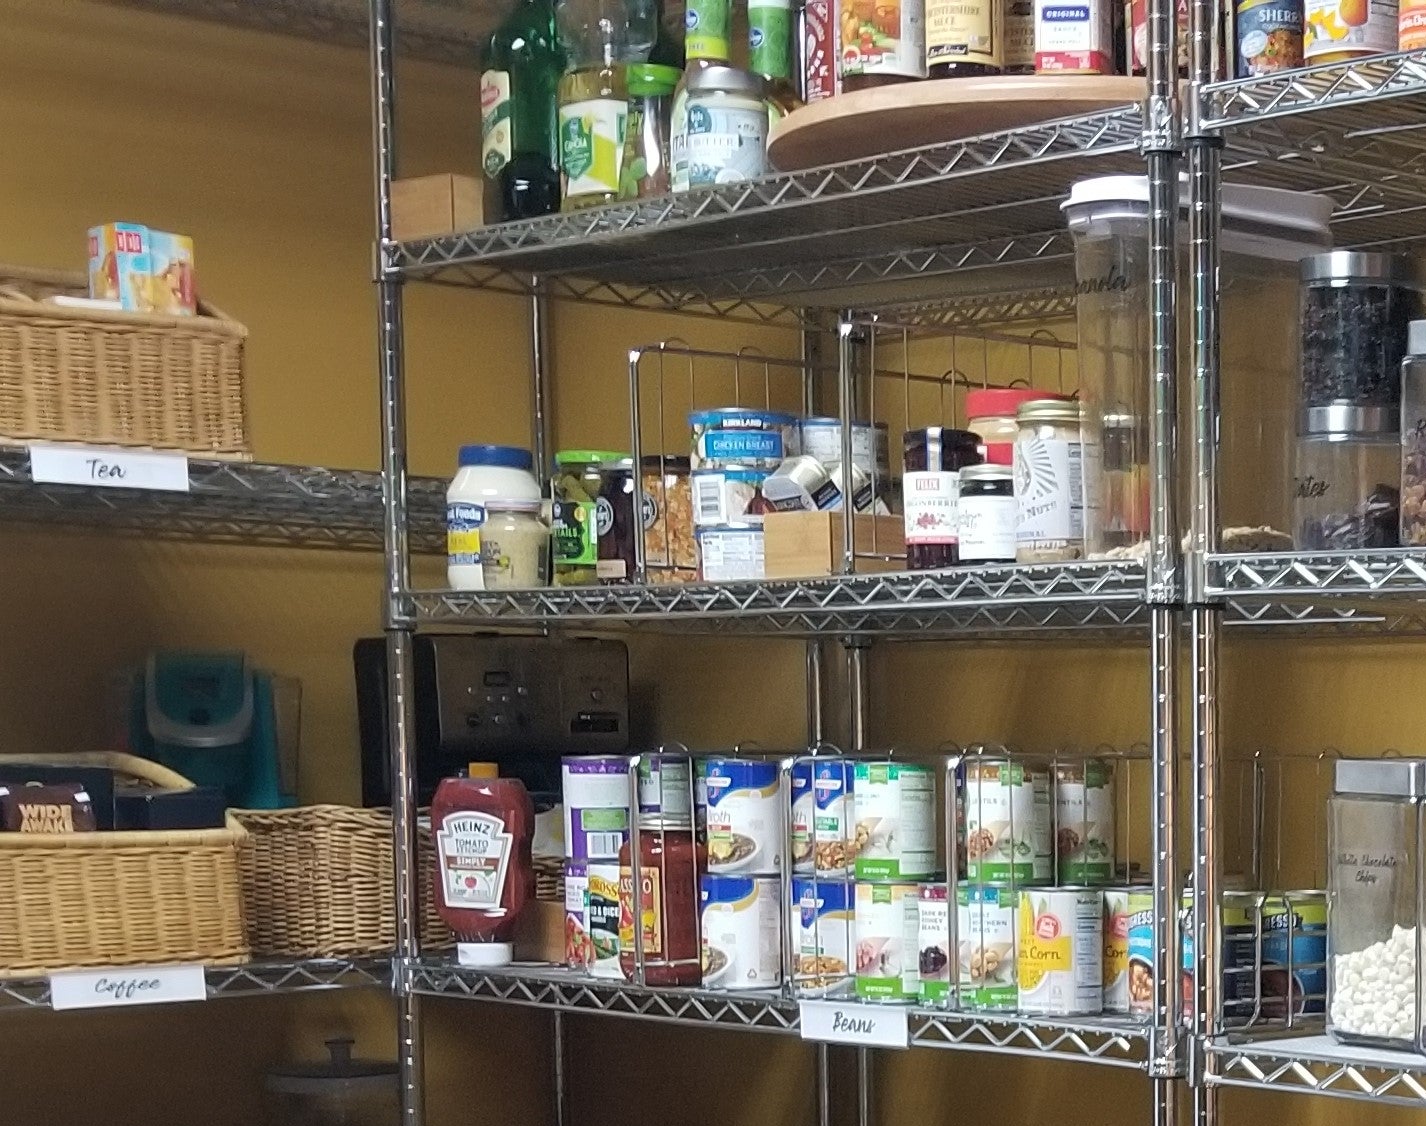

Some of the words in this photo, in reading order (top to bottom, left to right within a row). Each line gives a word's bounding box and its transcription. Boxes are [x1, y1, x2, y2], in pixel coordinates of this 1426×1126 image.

[87, 458, 127, 481] Tea
[18, 803, 72, 820] WIDE
[453, 821, 490, 835] HEINZ
[455, 838, 489, 848] TOMATO
[456, 857, 487, 866] SIMPLY
[1031, 945, 1060, 960] Corn
[1104, 944, 1126, 959] Cor
[94, 977, 161, 1000] Coffee
[832, 1010, 877, 1034] Beans
